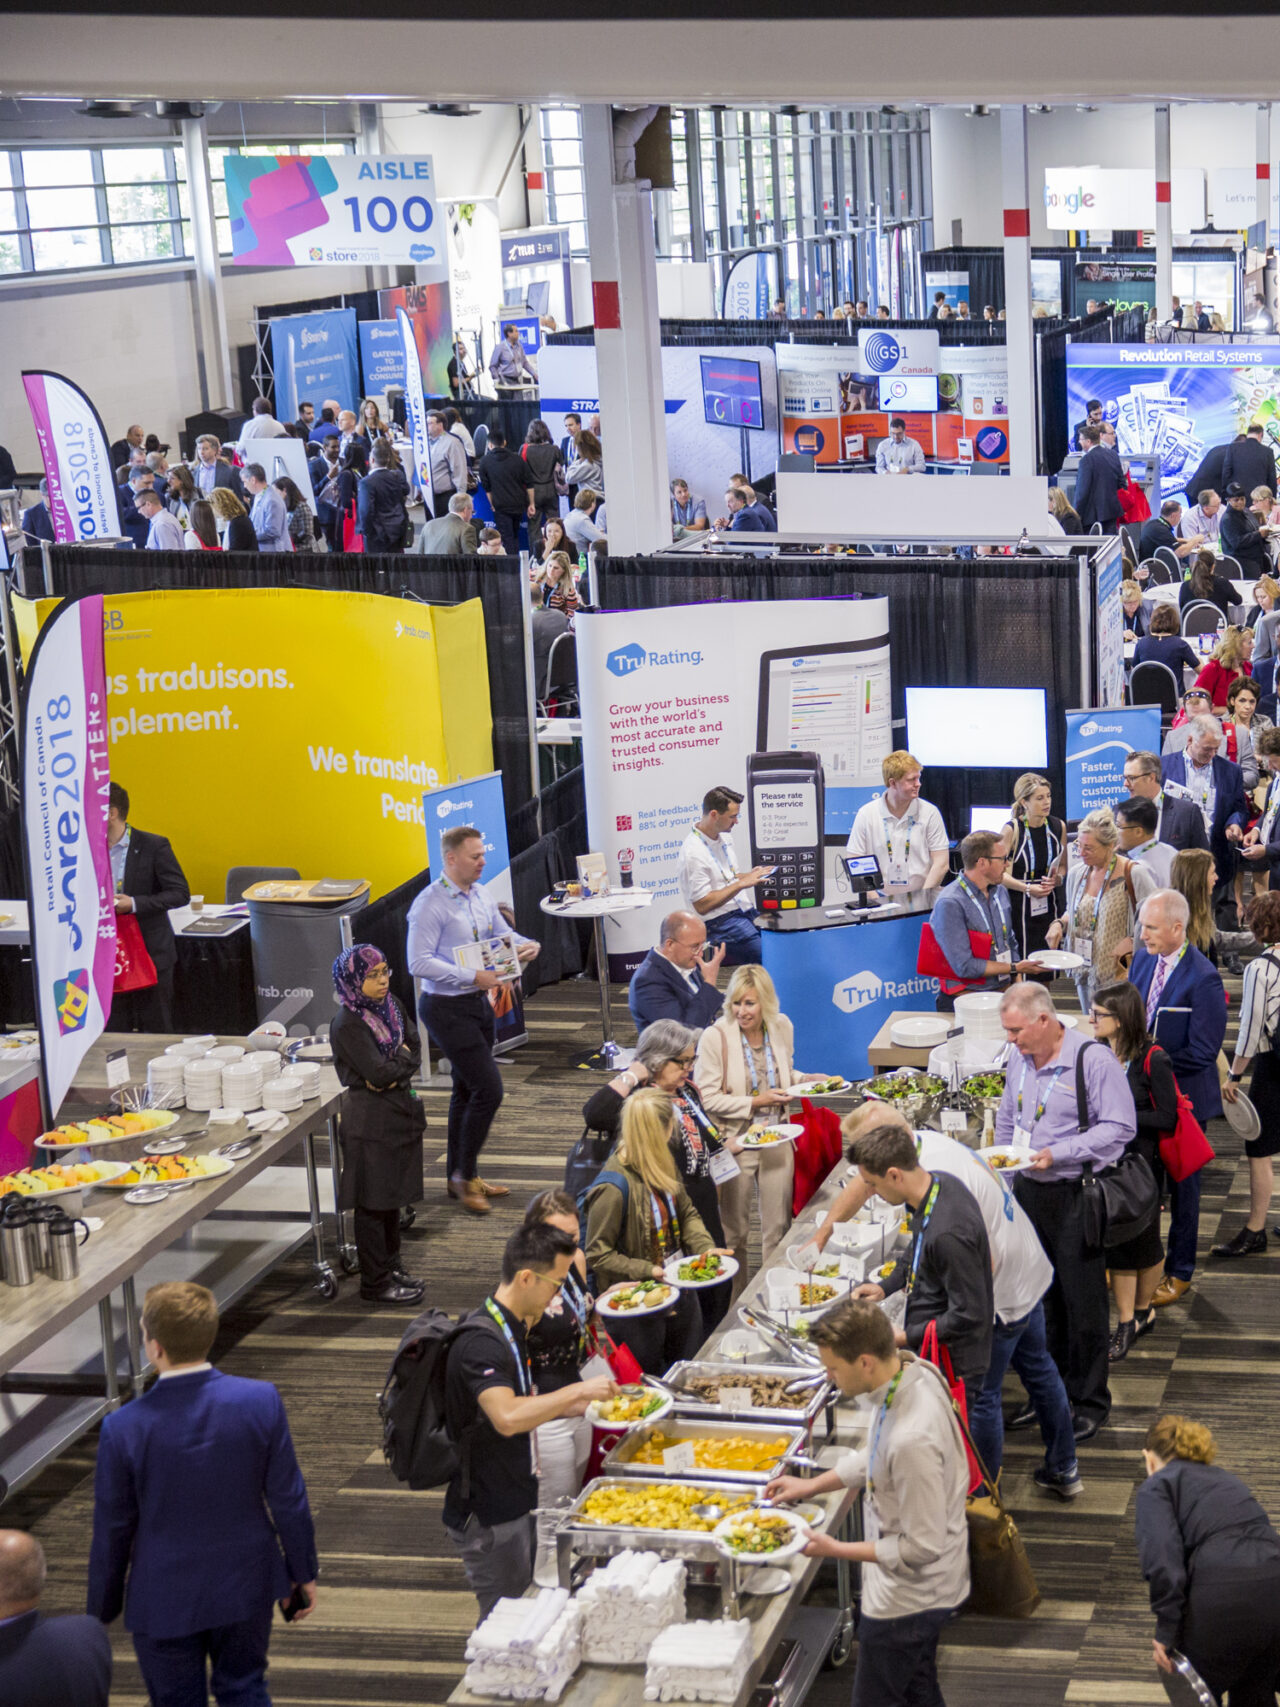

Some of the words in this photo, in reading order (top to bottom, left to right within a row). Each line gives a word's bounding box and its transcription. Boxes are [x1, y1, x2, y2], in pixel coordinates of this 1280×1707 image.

[358, 161, 430, 180] AISLE
[343, 196, 434, 233] 100
[326, 249, 381, 261] store2018
[878, 345, 909, 360] GS1
[1119, 348, 1183, 363] Revolution
[1184, 350, 1216, 363] Retail
[1216, 350, 1263, 365] Systems
[901, 366, 933, 374] Canada
[404, 624, 431, 640] trsb.com
[136, 661, 295, 694] traduisons.
[608, 702, 643, 716] Grow
[644, 699, 673, 714] your
[675, 694, 730, 708] business
[609, 716, 639, 730] with
[640, 715, 660, 726] the
[662, 708, 707, 723] world's
[610, 731, 642, 744] most
[644, 724, 696, 740] accurate
[698, 720, 724, 732] and
[34, 715, 46, 777] Canada
[611, 742, 656, 758] trusted
[658, 736, 721, 752] consumer
[307, 745, 348, 773] We
[352, 750, 444, 788] translate.
[612, 756, 665, 772] insights.
[1081, 762, 1117, 773] Faster,
[1081, 773, 1123, 784] smarter
[760, 792, 787, 801] Please
[787, 792, 804, 800] rate
[1081, 784, 1130, 797] custome
[637, 808, 657, 820] Real
[658, 803, 699, 817] feedback
[760, 800, 775, 808] the
[776, 800, 804, 809] service
[638, 819, 657, 831] 88%
[658, 818, 669, 828] of
[669, 815, 691, 828] your
[41, 801, 52, 870] Council
[638, 842, 662, 854] From
[663, 838, 684, 850] data
[638, 854, 649, 865] in
[650, 853, 662, 864] an
[639, 878, 657, 890] Use
[657, 876, 680, 889] your
[46, 875, 56, 912] Retail
[257, 984, 314, 999] trsb.com
